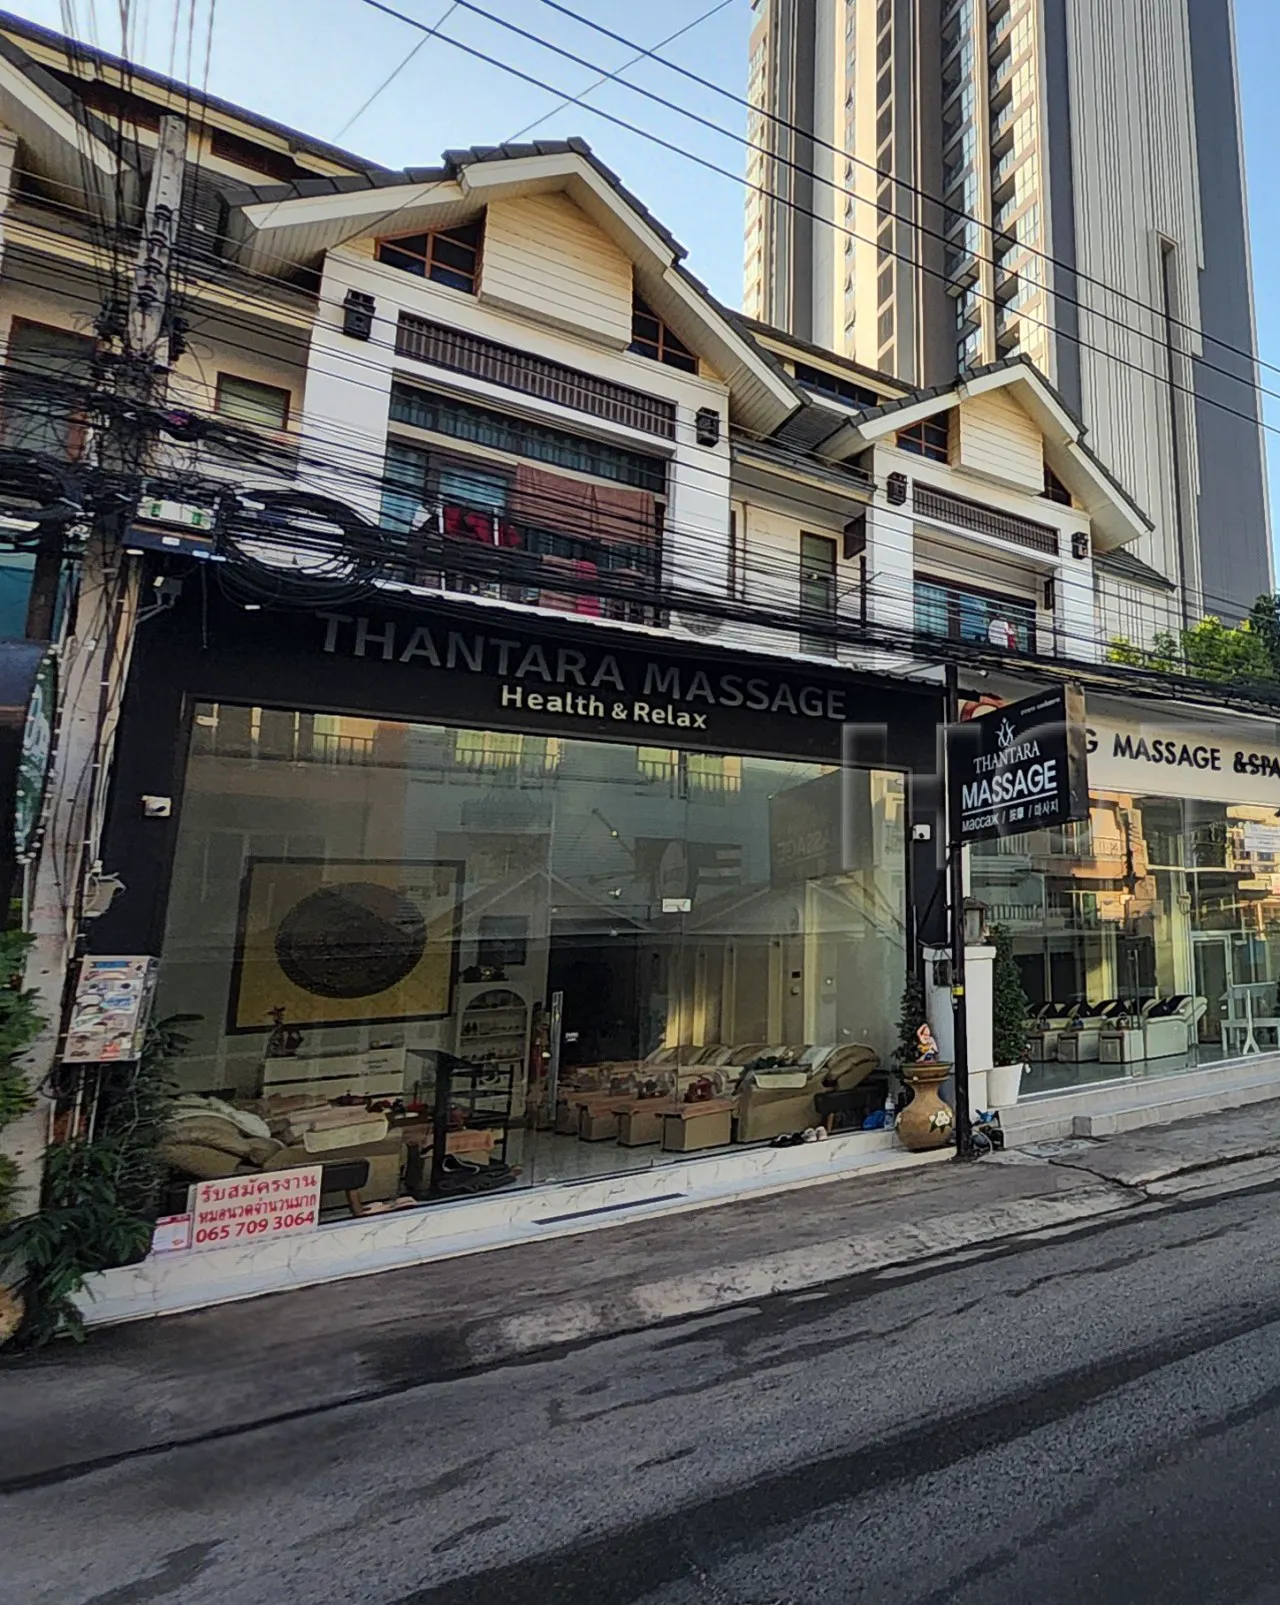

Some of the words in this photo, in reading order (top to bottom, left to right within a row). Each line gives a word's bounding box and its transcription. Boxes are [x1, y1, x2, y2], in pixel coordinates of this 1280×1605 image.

[316, 613, 625, 693] THANTARA
[643, 661, 847, 721] MASSAGE
[501, 684, 605, 719] Health
[611, 701, 629, 720] &
[633, 701, 708, 730] Relax
[973, 740, 1041, 774] THANTARA
[1112, 732, 1222, 771] MASSAGE
[962, 759, 1057, 811] MASSAGE
[200, 1173, 318, 1204] รับสมัครงาน
[195, 1224, 230, 1244] 065
[234, 1218, 269, 1238] 709
[272, 1210, 316, 1231] 3064
[198, 1193, 318, 1225] หมอนวดจำนวนมาก
